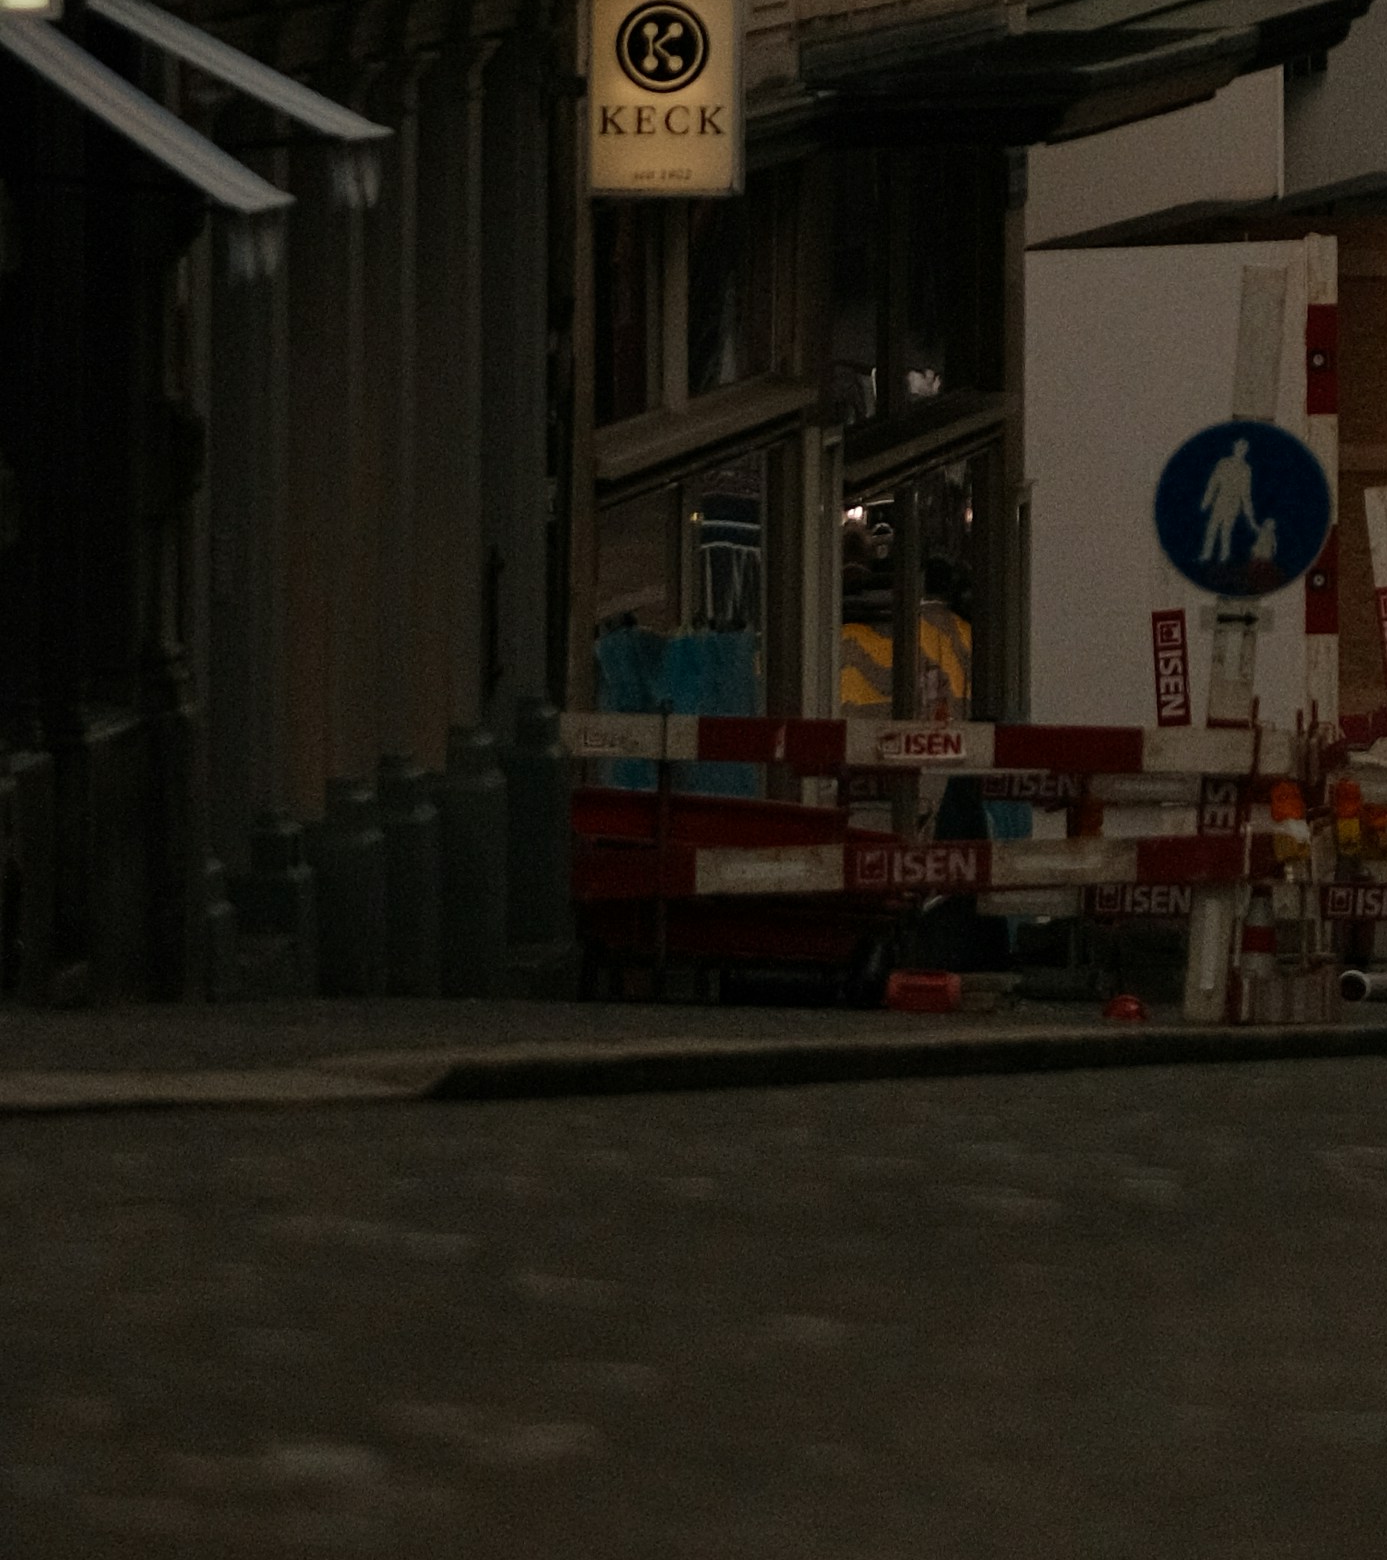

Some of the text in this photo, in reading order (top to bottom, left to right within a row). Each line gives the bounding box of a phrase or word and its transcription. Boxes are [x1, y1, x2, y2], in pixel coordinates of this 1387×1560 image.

[599, 105, 725, 136] KECK
[1158, 650, 1185, 719] ISEN
[904, 733, 963, 755] ISEN
[893, 850, 977, 882] ISEN
[1125, 886, 1192, 913] ISEN
